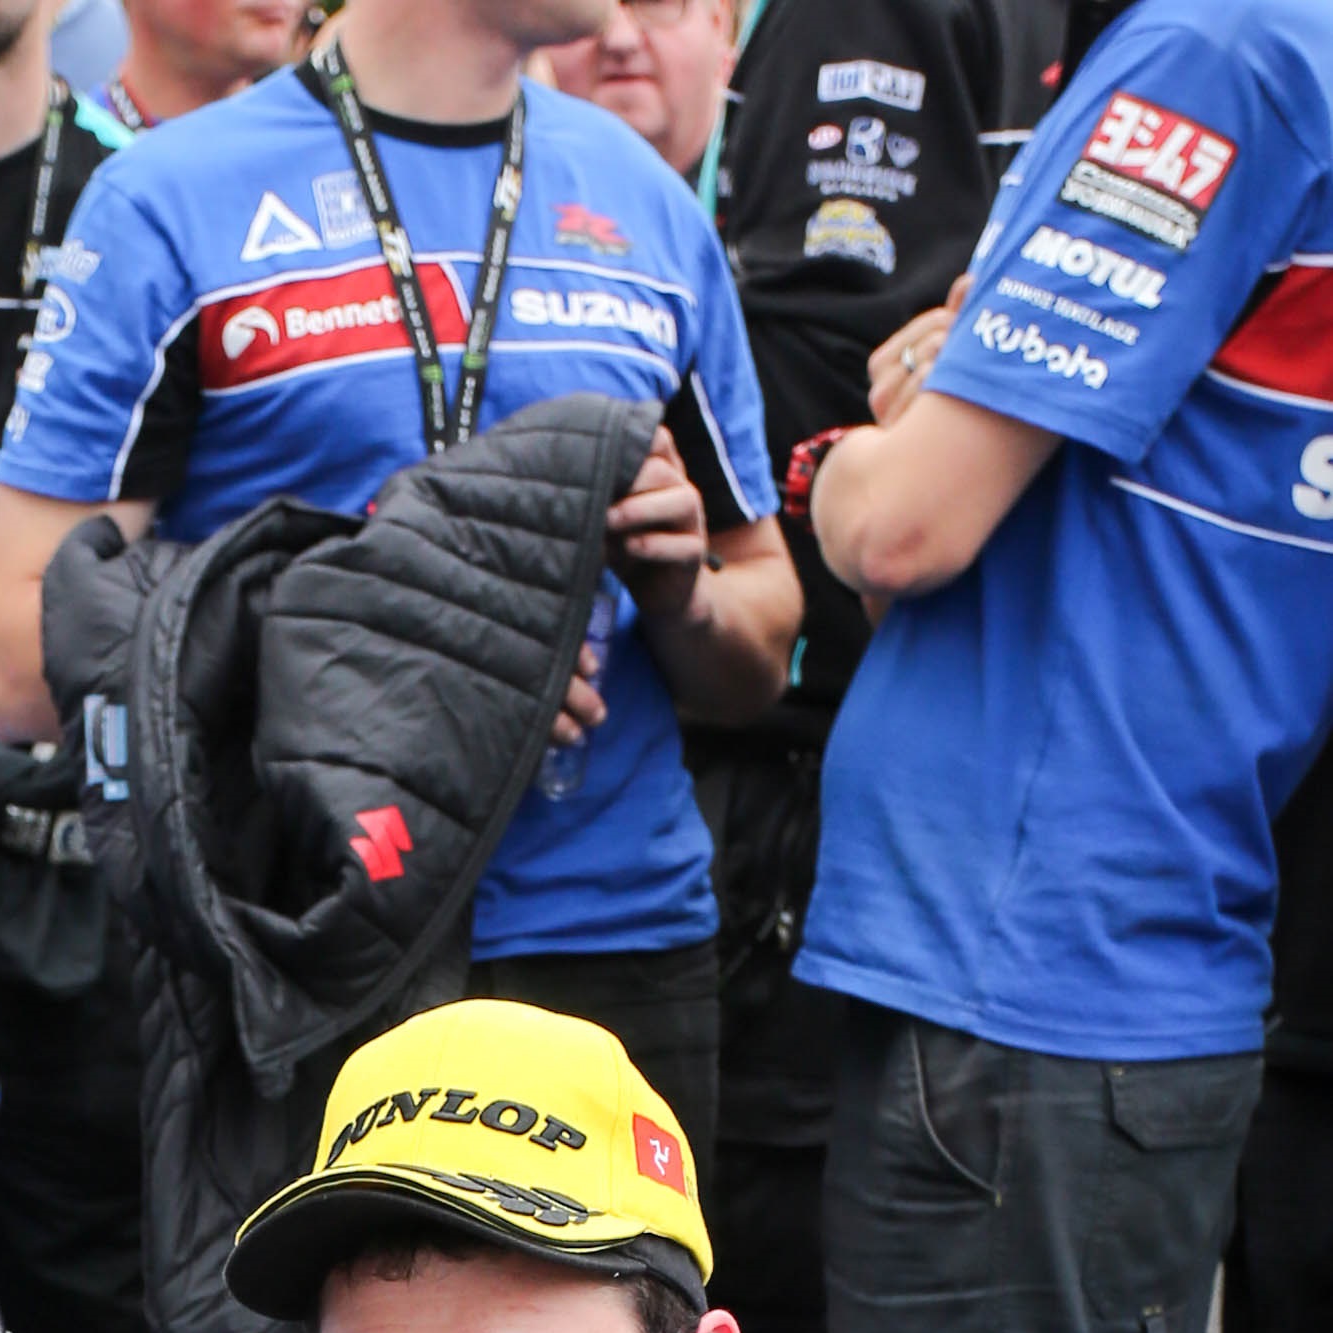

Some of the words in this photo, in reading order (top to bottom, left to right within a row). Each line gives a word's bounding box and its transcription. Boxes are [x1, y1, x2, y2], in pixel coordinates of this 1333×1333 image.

[1087, 97, 1233, 202] ヨシムラ
[1020, 225, 1166, 309] MOTUL
[285, 296, 404, 339] Bennet
[510, 287, 679, 350] SUZUKI
[972, 308, 1108, 390] Kubota
[325, 1087, 587, 1166] DUNLOP
